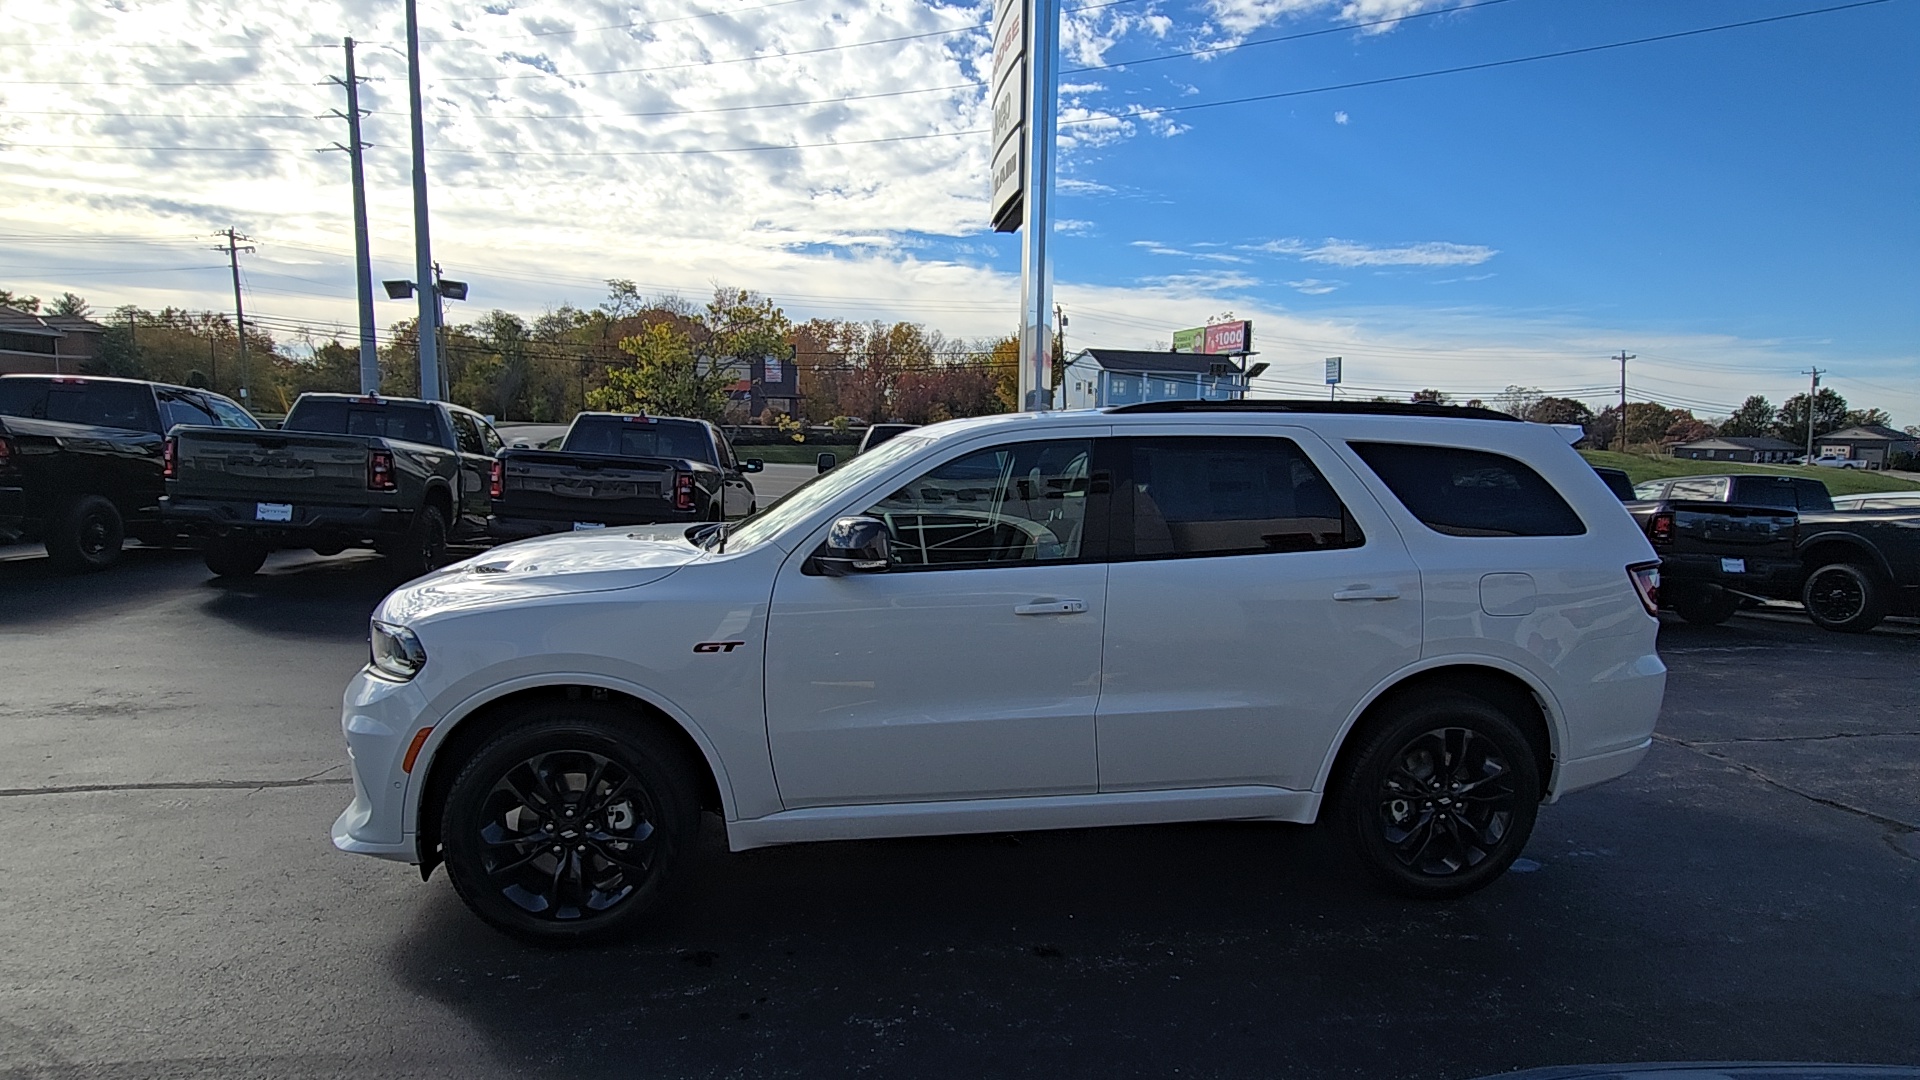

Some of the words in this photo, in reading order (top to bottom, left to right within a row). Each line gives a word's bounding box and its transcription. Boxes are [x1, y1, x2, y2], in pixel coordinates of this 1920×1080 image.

[992, 13, 1020, 87] ODGE
[1215, 329, 1242, 346] $1000
[693, 641, 745, 653] GT
